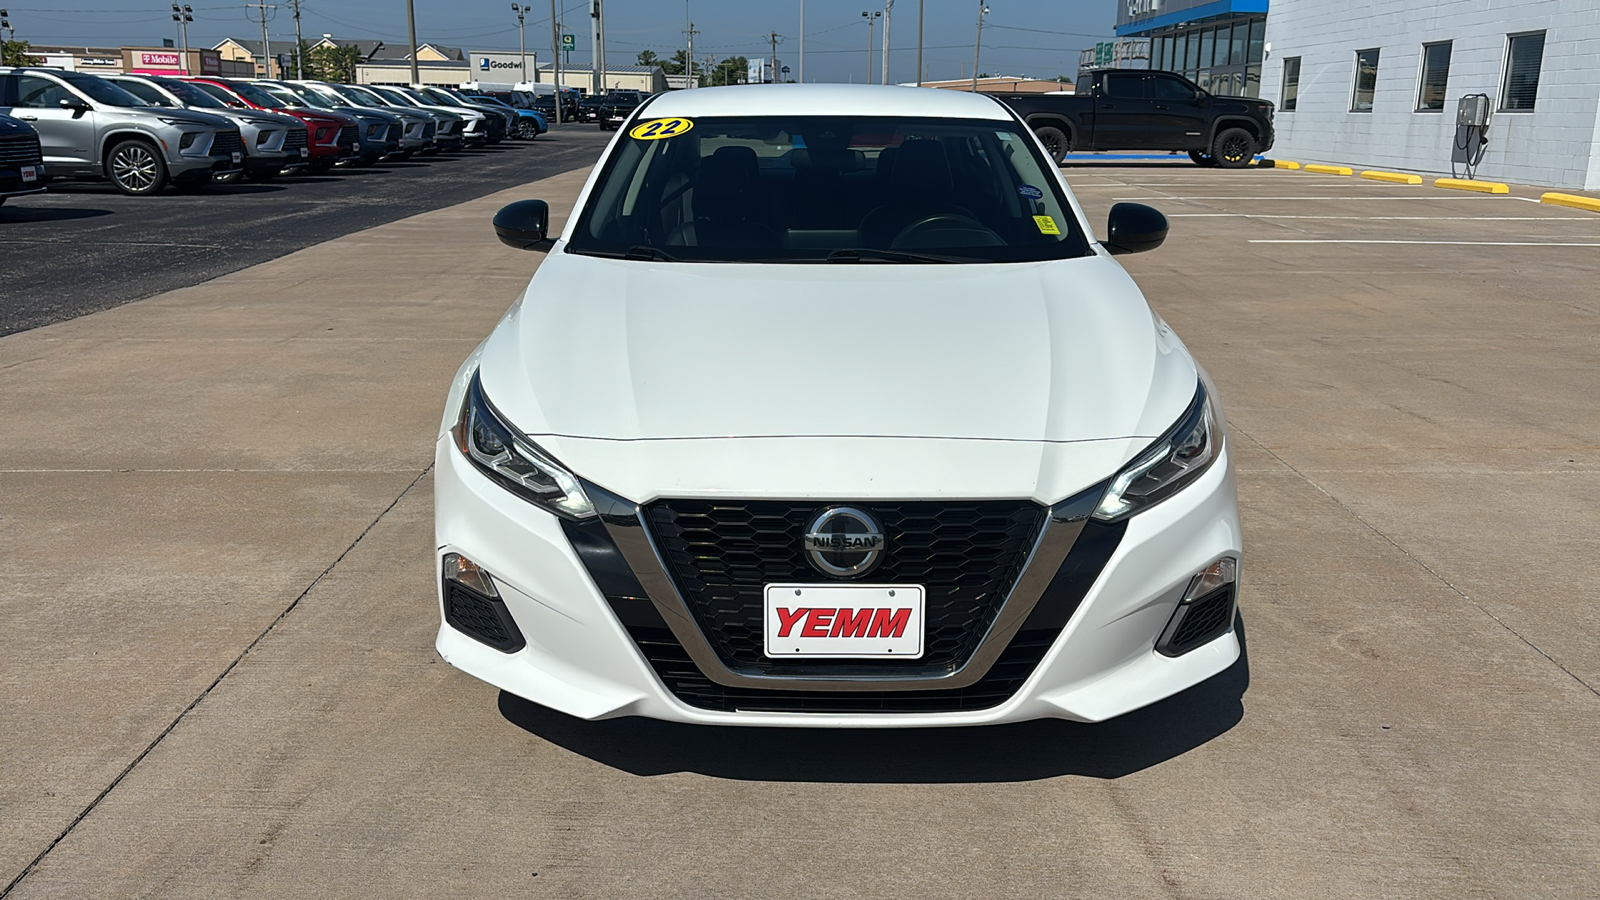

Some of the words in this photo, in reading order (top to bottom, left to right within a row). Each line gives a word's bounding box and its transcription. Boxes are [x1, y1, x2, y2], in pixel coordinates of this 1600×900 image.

[490, 60, 523, 69] Goodwi
[641, 120, 681, 137] 22
[813, 536, 876, 548] NISSAN
[776, 607, 913, 638] YEMM
